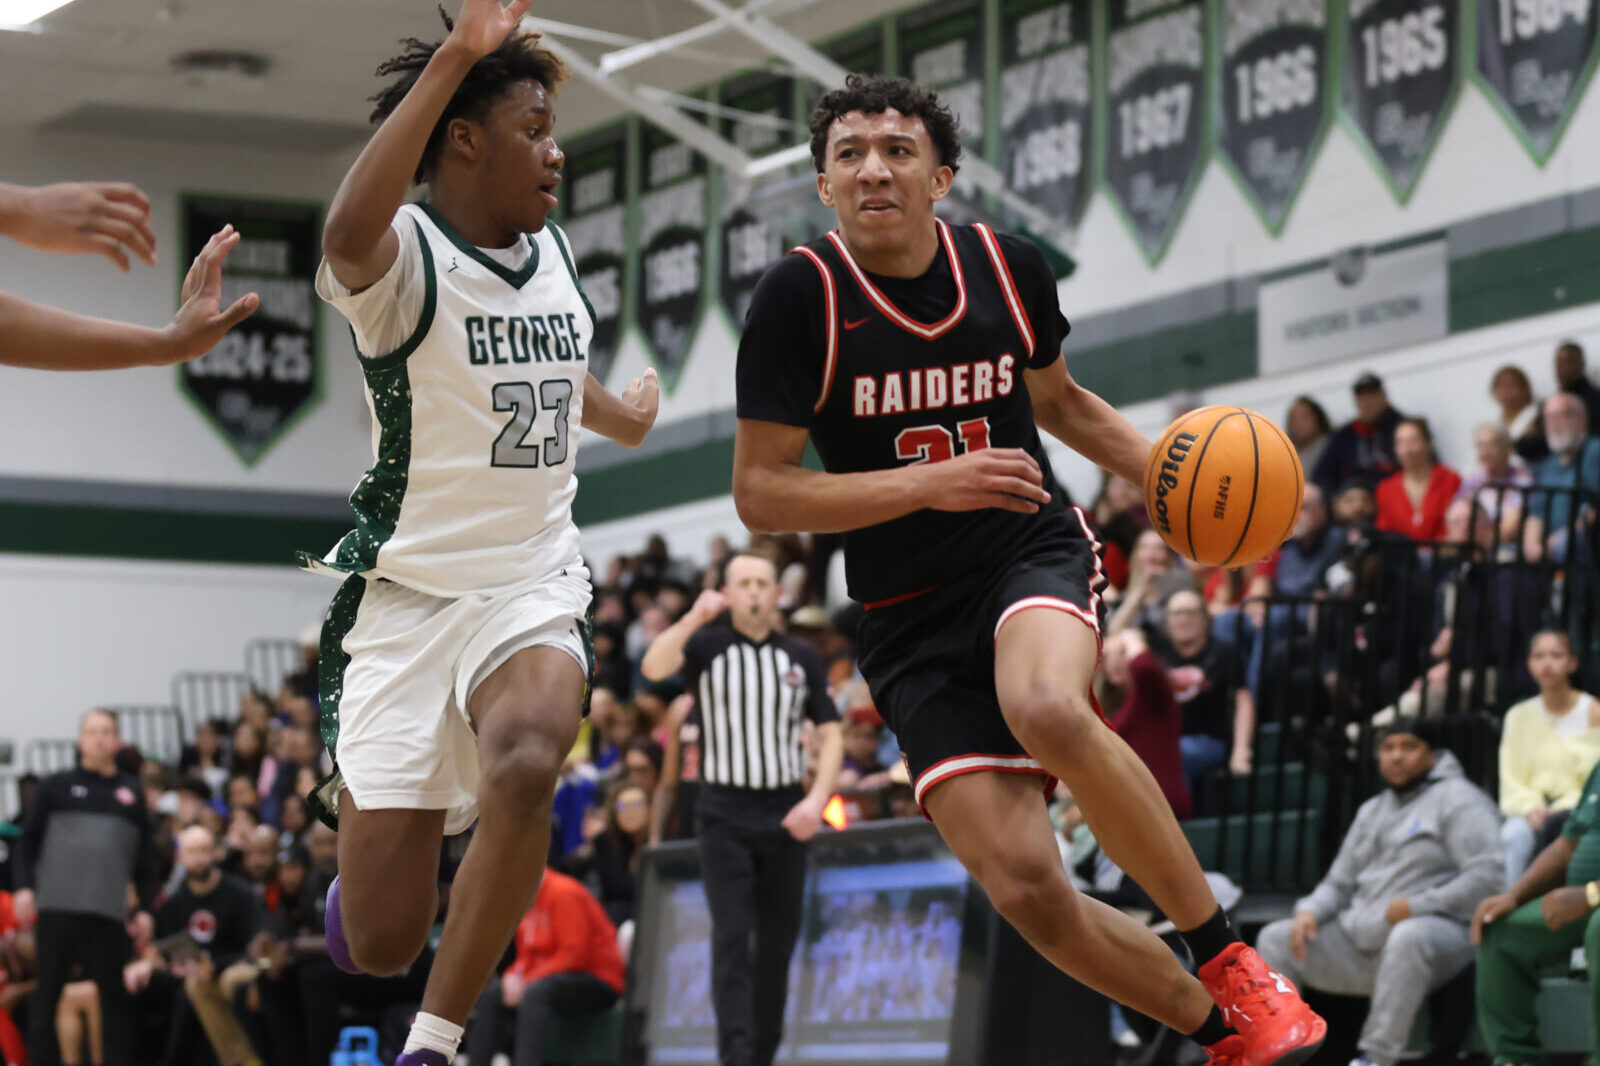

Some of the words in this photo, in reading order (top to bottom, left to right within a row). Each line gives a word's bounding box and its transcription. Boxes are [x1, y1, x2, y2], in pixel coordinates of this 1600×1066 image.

[1236, 44, 1317, 124] 1966
[1362, 4, 1447, 88] 1965
[1118, 82, 1193, 158] 1967
[465, 313, 585, 365] GEORGE
[490, 379, 572, 468] 23
[853, 353, 1015, 418] RAIDERS
[1155, 432, 1199, 534] Wilson
